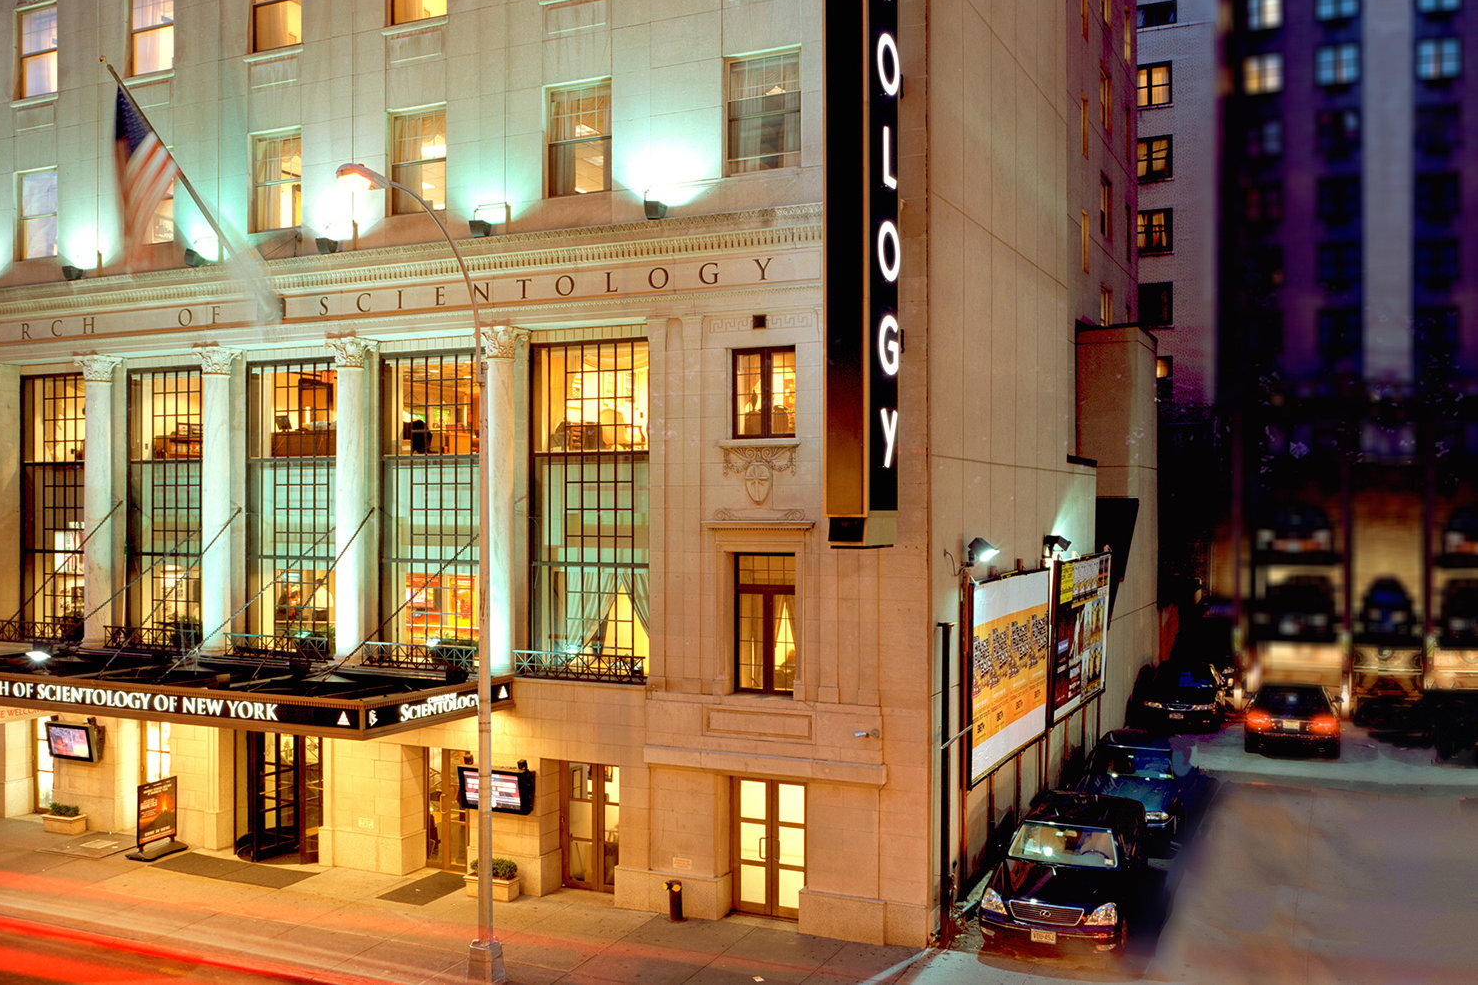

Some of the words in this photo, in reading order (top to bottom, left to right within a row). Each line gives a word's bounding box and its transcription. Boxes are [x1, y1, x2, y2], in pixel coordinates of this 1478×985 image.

[177, 306, 221, 327] OF
[319, 257, 774, 316] SCIENTOLOGY
[6, 707, 48, 717] WELCO
[12, 681, 34, 698] OF
[37, 683, 151, 710] SCIENTOLOGY
[153, 694, 178, 713] OF
[182, 696, 224, 717] NEW
[225, 699, 279, 721] YORK
